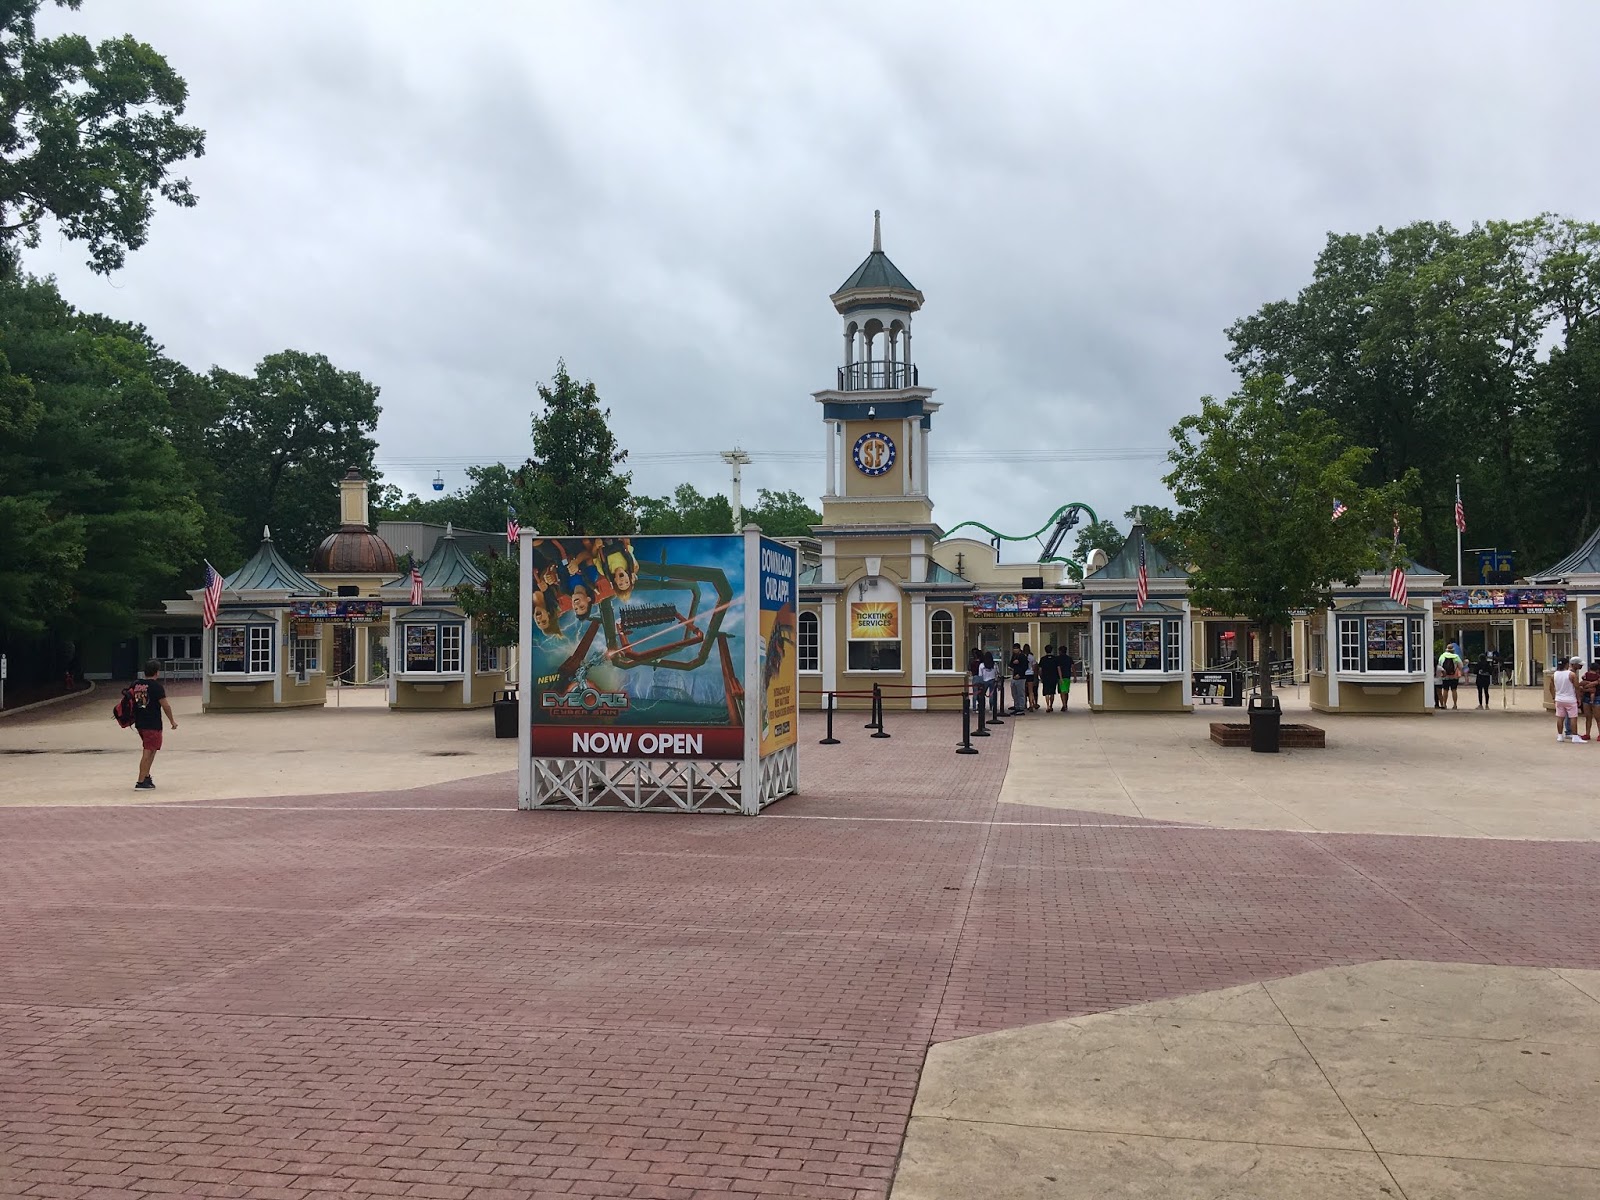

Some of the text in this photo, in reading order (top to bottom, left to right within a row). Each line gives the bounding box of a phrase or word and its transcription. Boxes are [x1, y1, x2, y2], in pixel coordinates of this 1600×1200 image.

[864, 440, 885, 467] SF
[761, 547, 792, 578] DOWNLOAD
[765, 576, 790, 602] OUR APP!
[856, 612, 893, 620] TICKETING
[537, 674, 560, 685] NEW!
[542, 688, 628, 711] CYBORG
[572, 732, 703, 754] NOW OPEN
